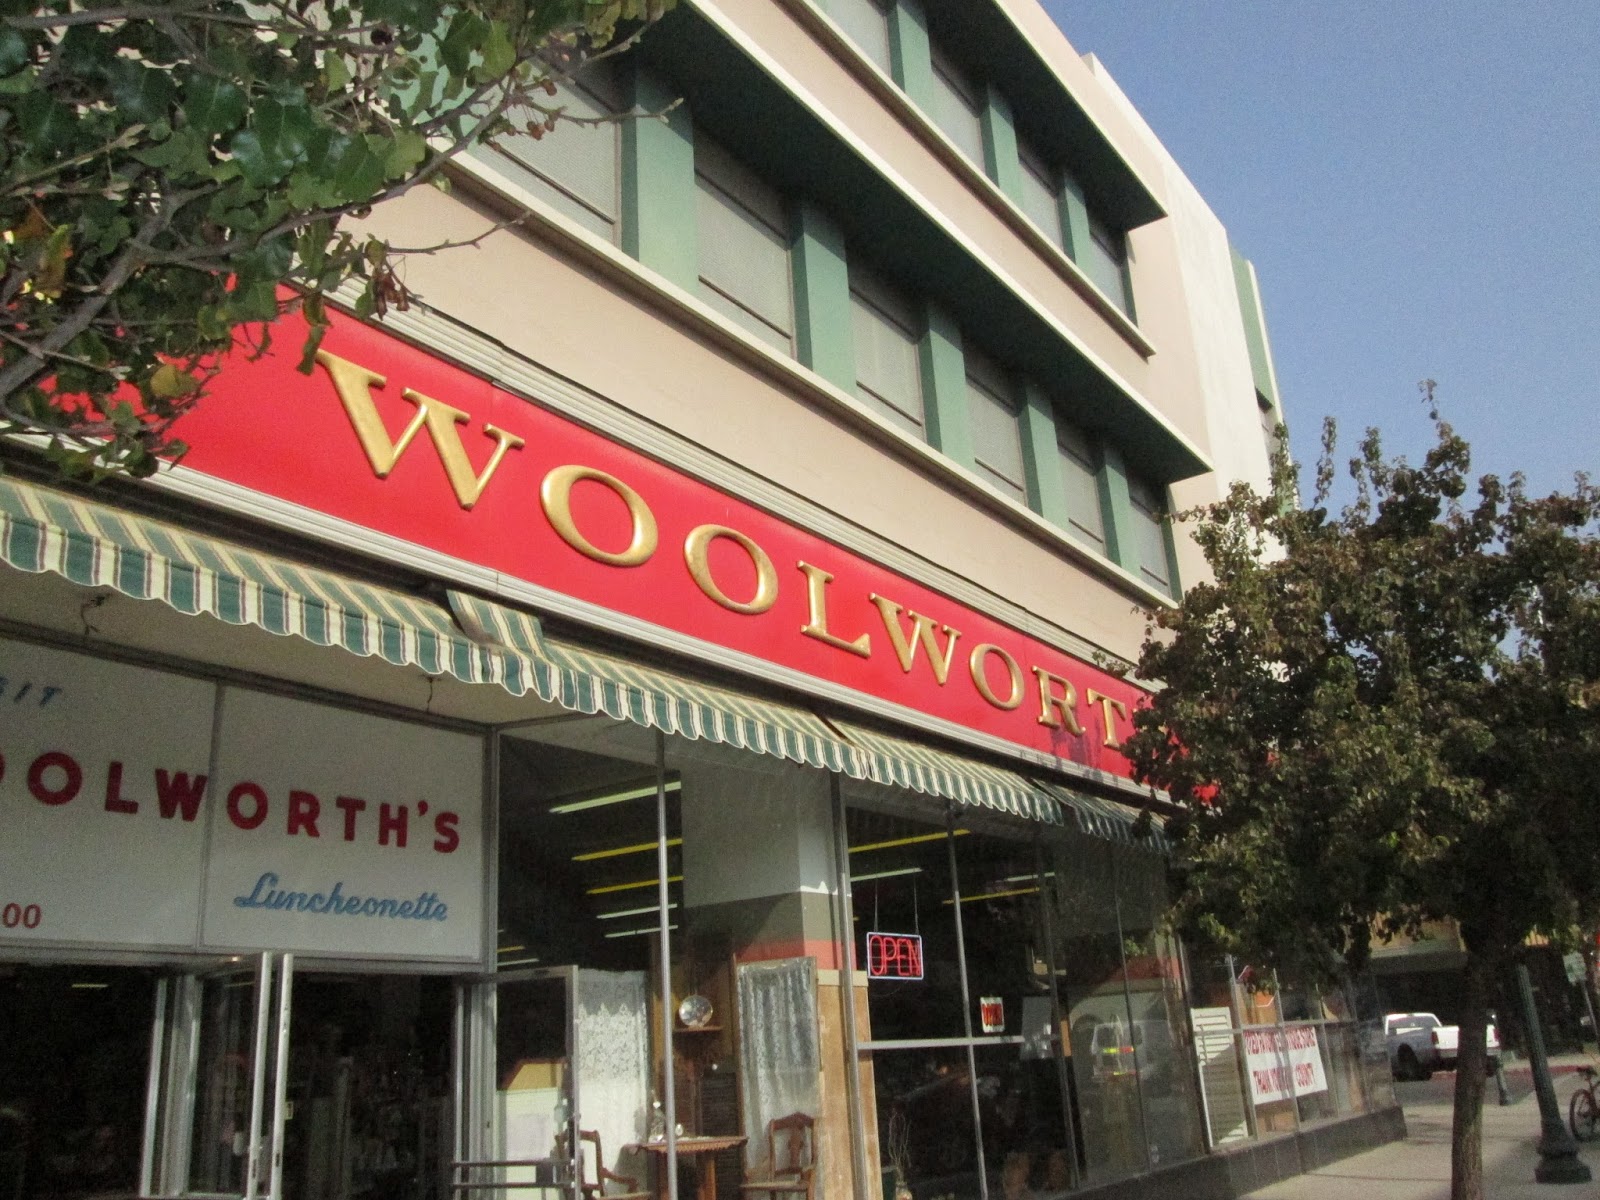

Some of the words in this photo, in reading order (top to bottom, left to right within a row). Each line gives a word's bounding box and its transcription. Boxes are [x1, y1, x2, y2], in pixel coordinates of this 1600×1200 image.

[315, 349, 1170, 770] WOOLWORT
[0, 749, 460, 853] OLWORTH'S
[233, 871, 449, 921] Luncheonette
[869, 935, 921, 976] OPEN
